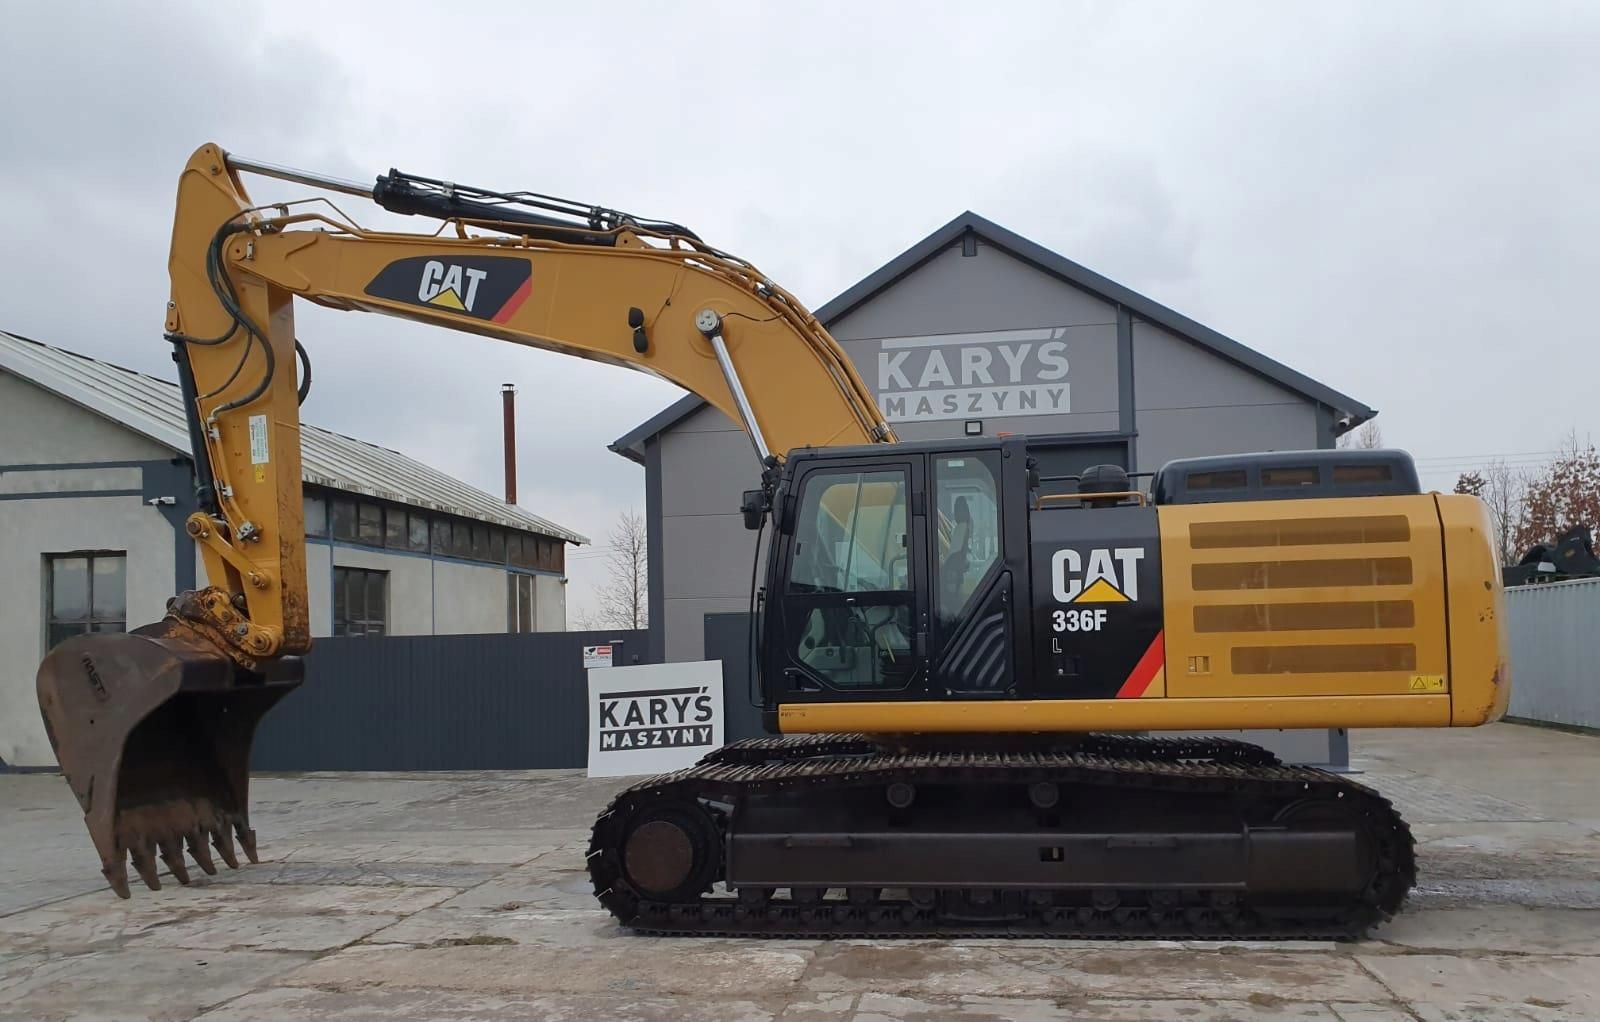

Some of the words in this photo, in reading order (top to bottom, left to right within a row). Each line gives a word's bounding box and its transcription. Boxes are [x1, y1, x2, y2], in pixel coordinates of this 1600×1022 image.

[418, 260, 488, 312] CAT
[878, 328, 1070, 390] KARYŚ
[886, 388, 1065, 417] MASZYNY
[1052, 547, 1145, 603] CAT
[1052, 609, 1107, 632] 336F
[1052, 637, 1063, 653] L
[599, 686, 713, 729] KARYŚ
[602, 727, 711, 749] MASZYNY
